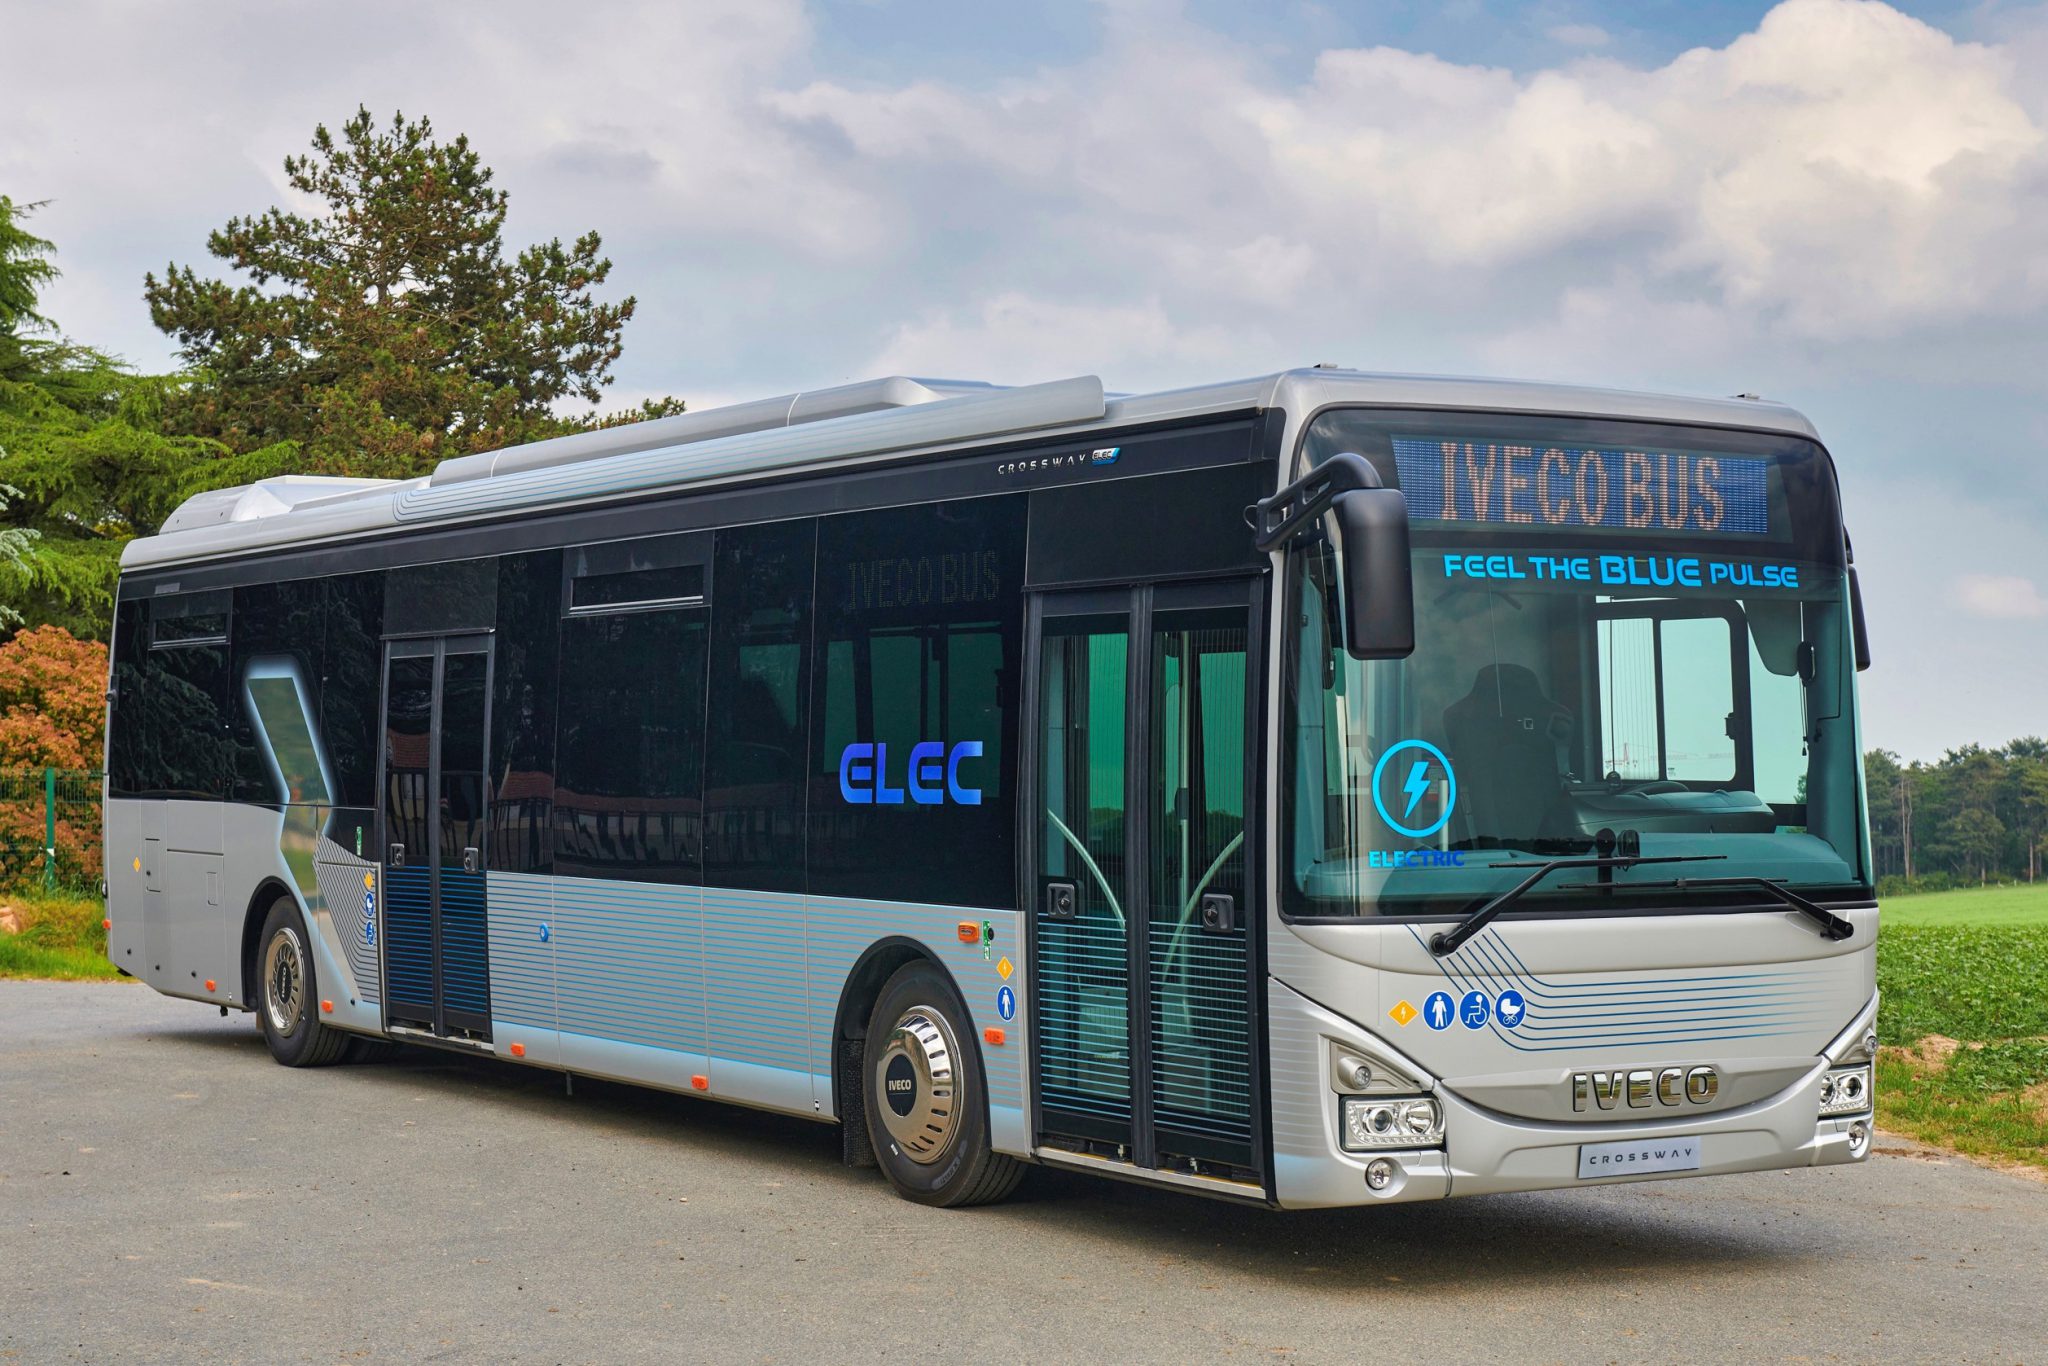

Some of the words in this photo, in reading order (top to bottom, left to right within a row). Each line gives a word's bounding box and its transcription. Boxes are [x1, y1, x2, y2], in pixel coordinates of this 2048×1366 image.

[998, 454, 1086, 474] CROSSWAY
[1441, 442, 1608, 526] IVECO
[1624, 452, 1724, 531] BUS
[849, 556, 933, 609] IVECO
[942, 549, 999, 604] BUS
[1444, 554, 1526, 579] FEEL
[1528, 556, 1592, 580] THE
[1600, 555, 1702, 587] BLUE
[1709, 562, 1799, 588] PULSE
[839, 741, 983, 805] ELEC
[1368, 850, 1465, 868] ELECTRIC
[888, 1079, 912, 1091] IVECO
[1572, 1065, 1719, 1113] IVECO
[1589, 1148, 1692, 1165] CROSSWAY
